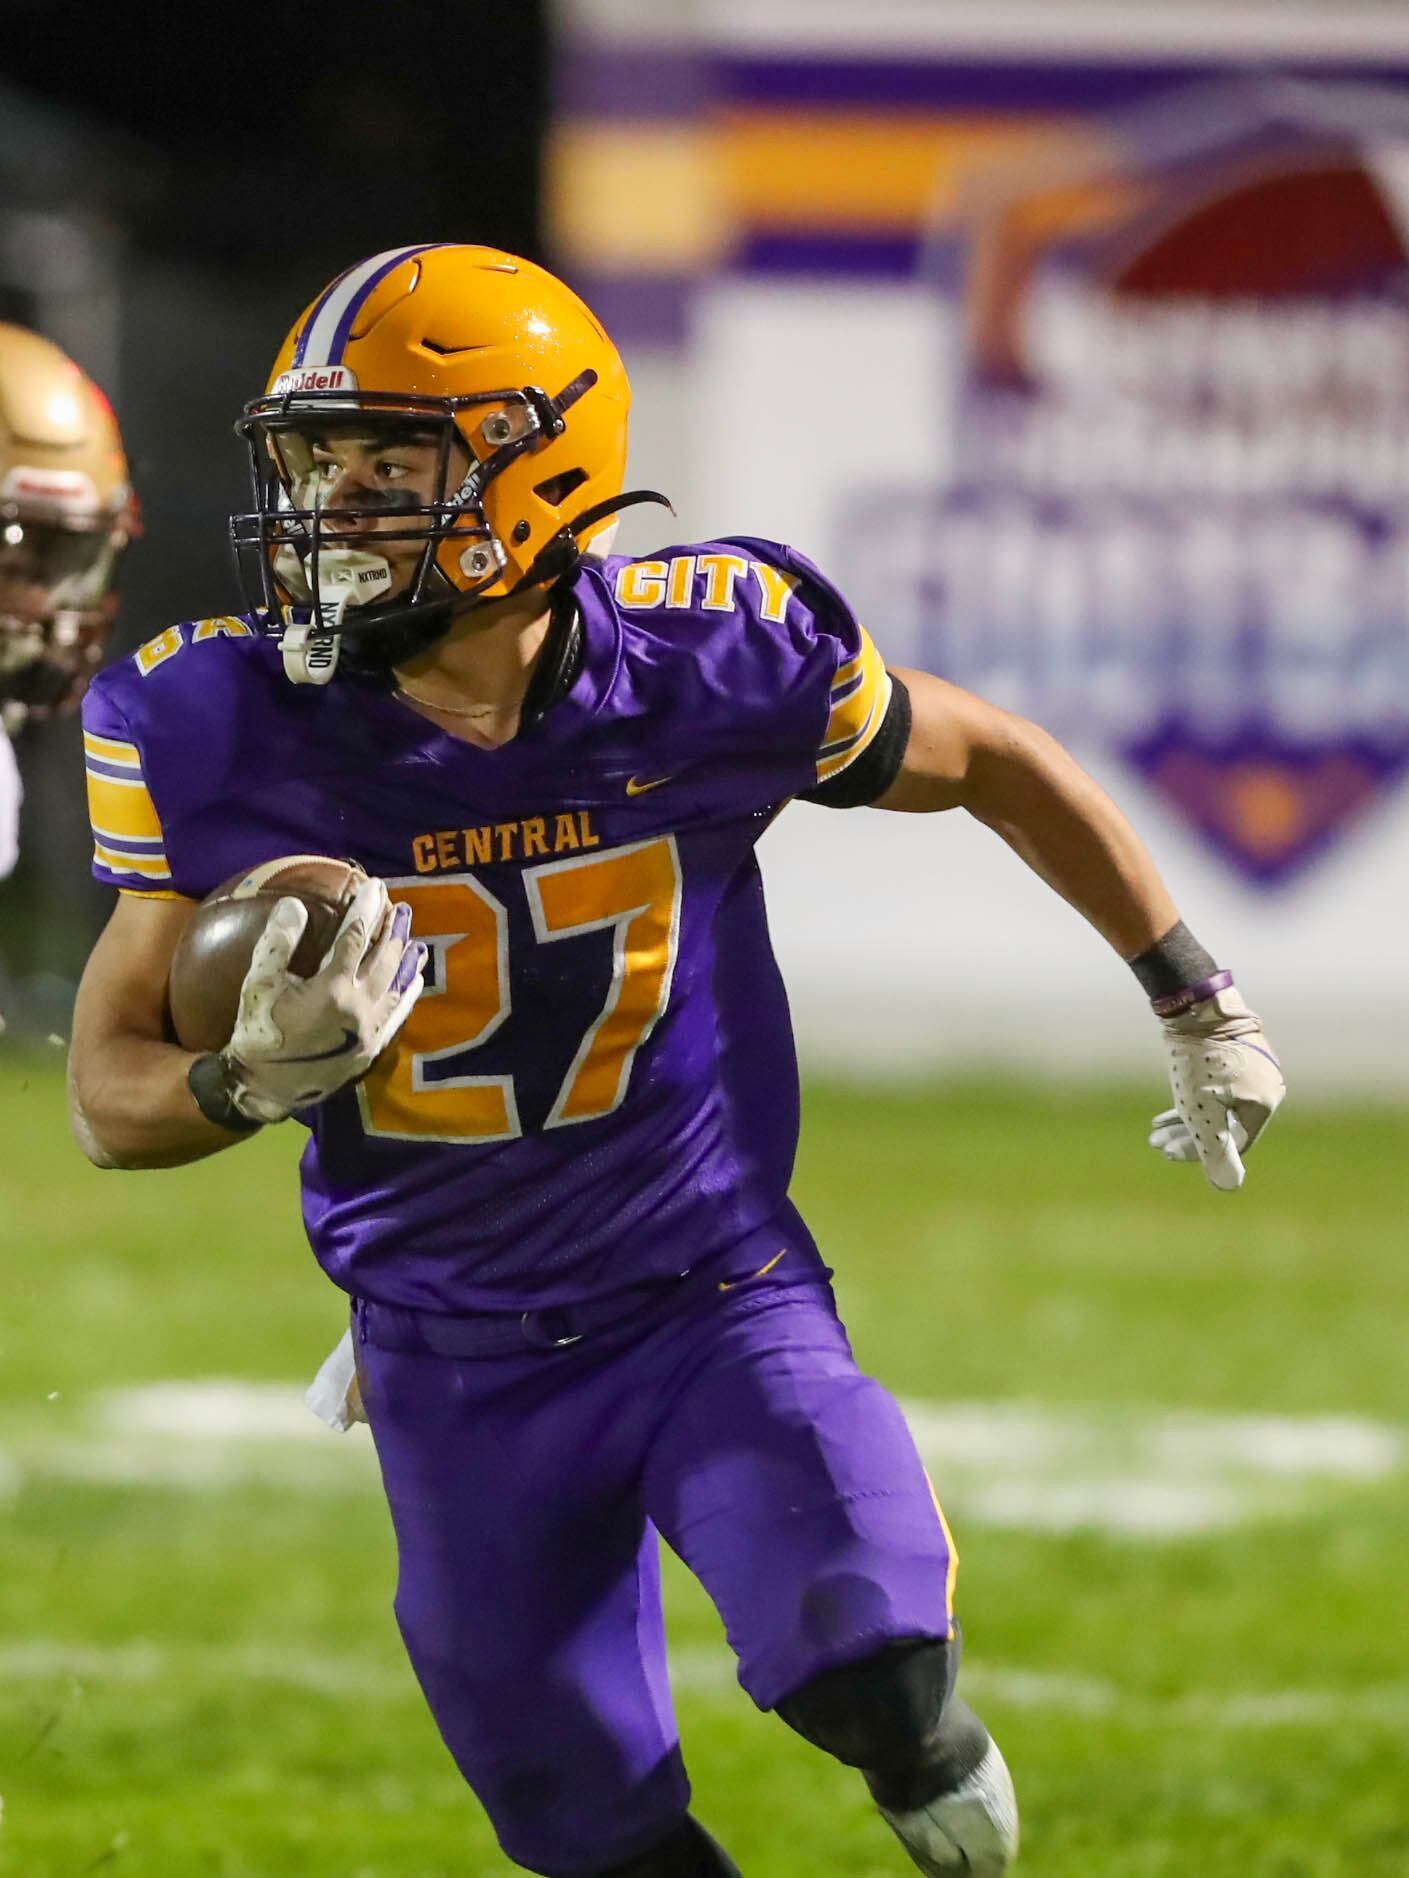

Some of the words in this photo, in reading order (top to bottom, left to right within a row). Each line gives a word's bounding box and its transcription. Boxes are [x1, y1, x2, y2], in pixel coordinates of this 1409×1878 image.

[615, 554, 801, 624] CITY
[308, 602, 341, 669] NXRND
[412, 811, 599, 873] CENTRAL
[360, 834, 682, 1144] 27
